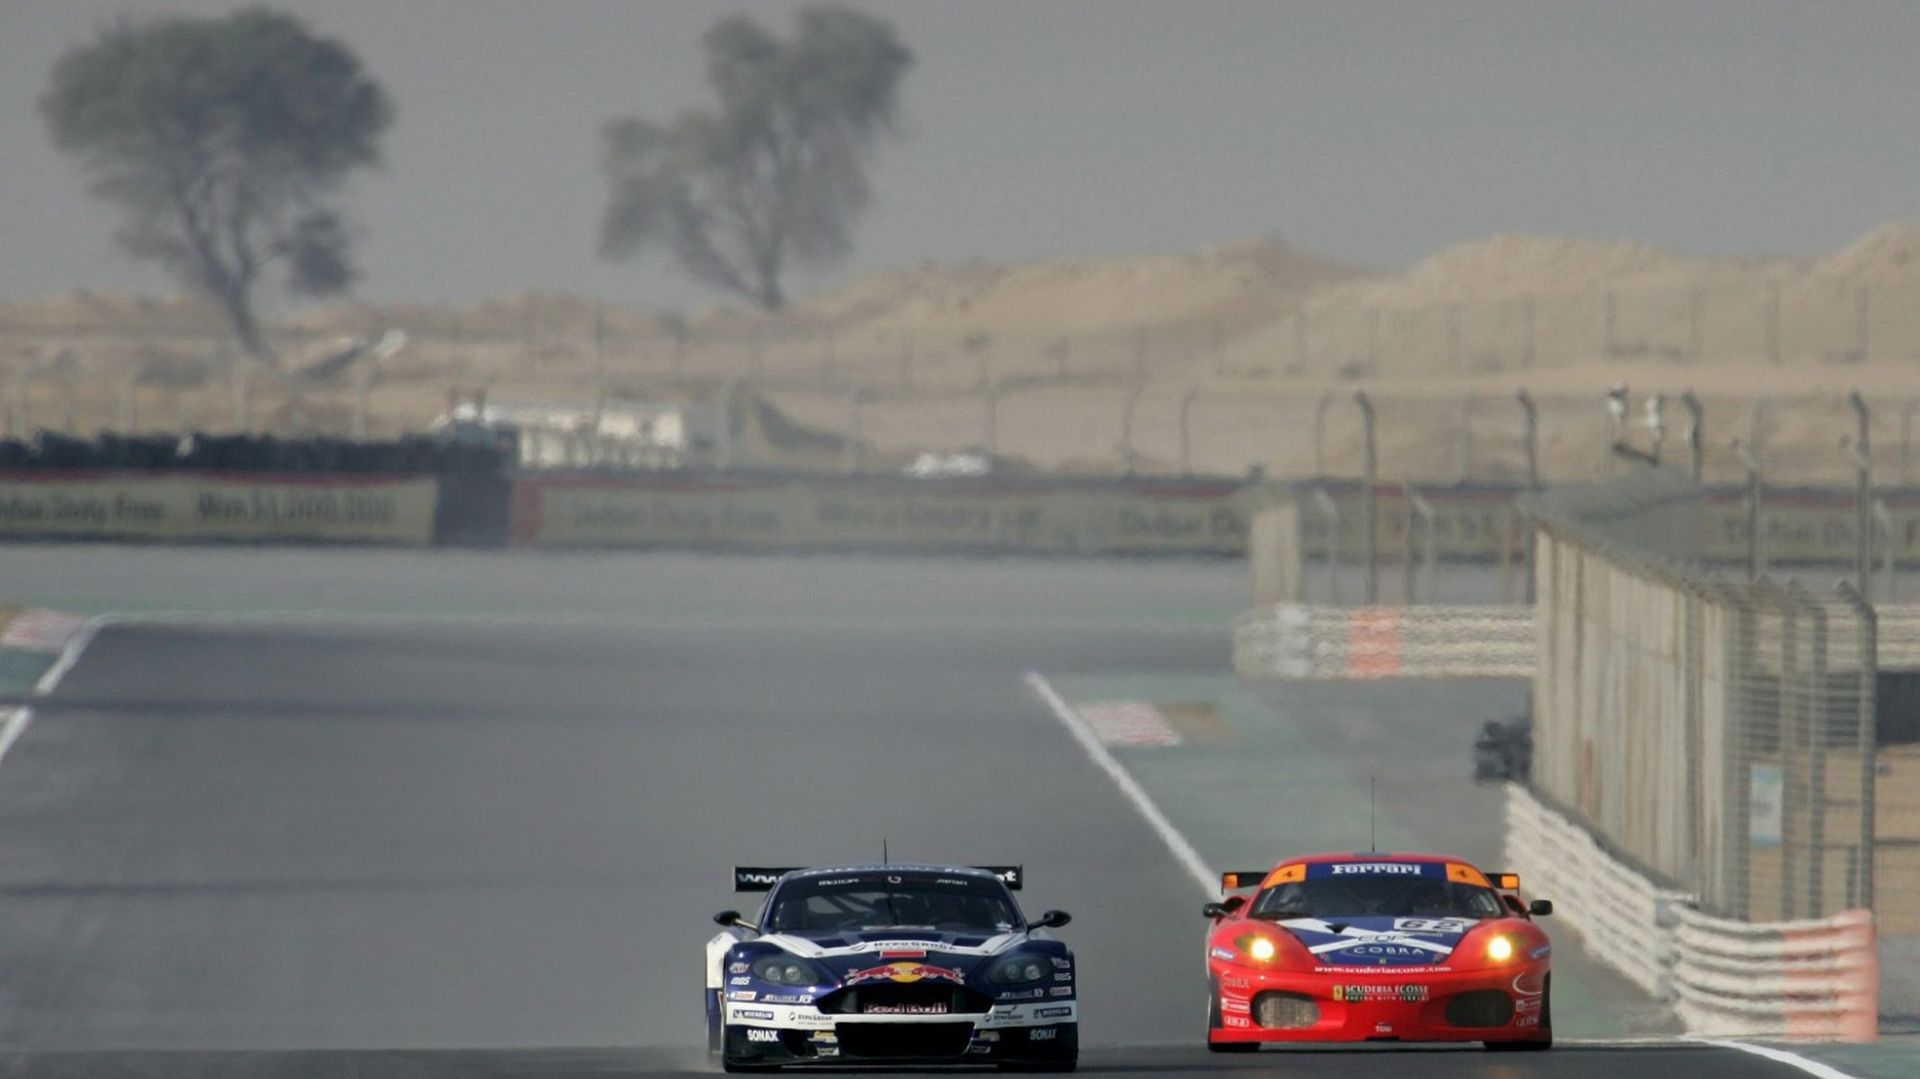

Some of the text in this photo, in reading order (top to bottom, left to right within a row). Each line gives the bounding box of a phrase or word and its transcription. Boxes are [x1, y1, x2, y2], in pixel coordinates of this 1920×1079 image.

[1332, 864, 1420, 875] Ferrari
[1400, 920, 1458, 930] 62
[1353, 947, 1424, 955] COBRA
[1345, 985, 1428, 993] SCUDERIA ECOSSE
[747, 1030, 779, 1042] SONAX
